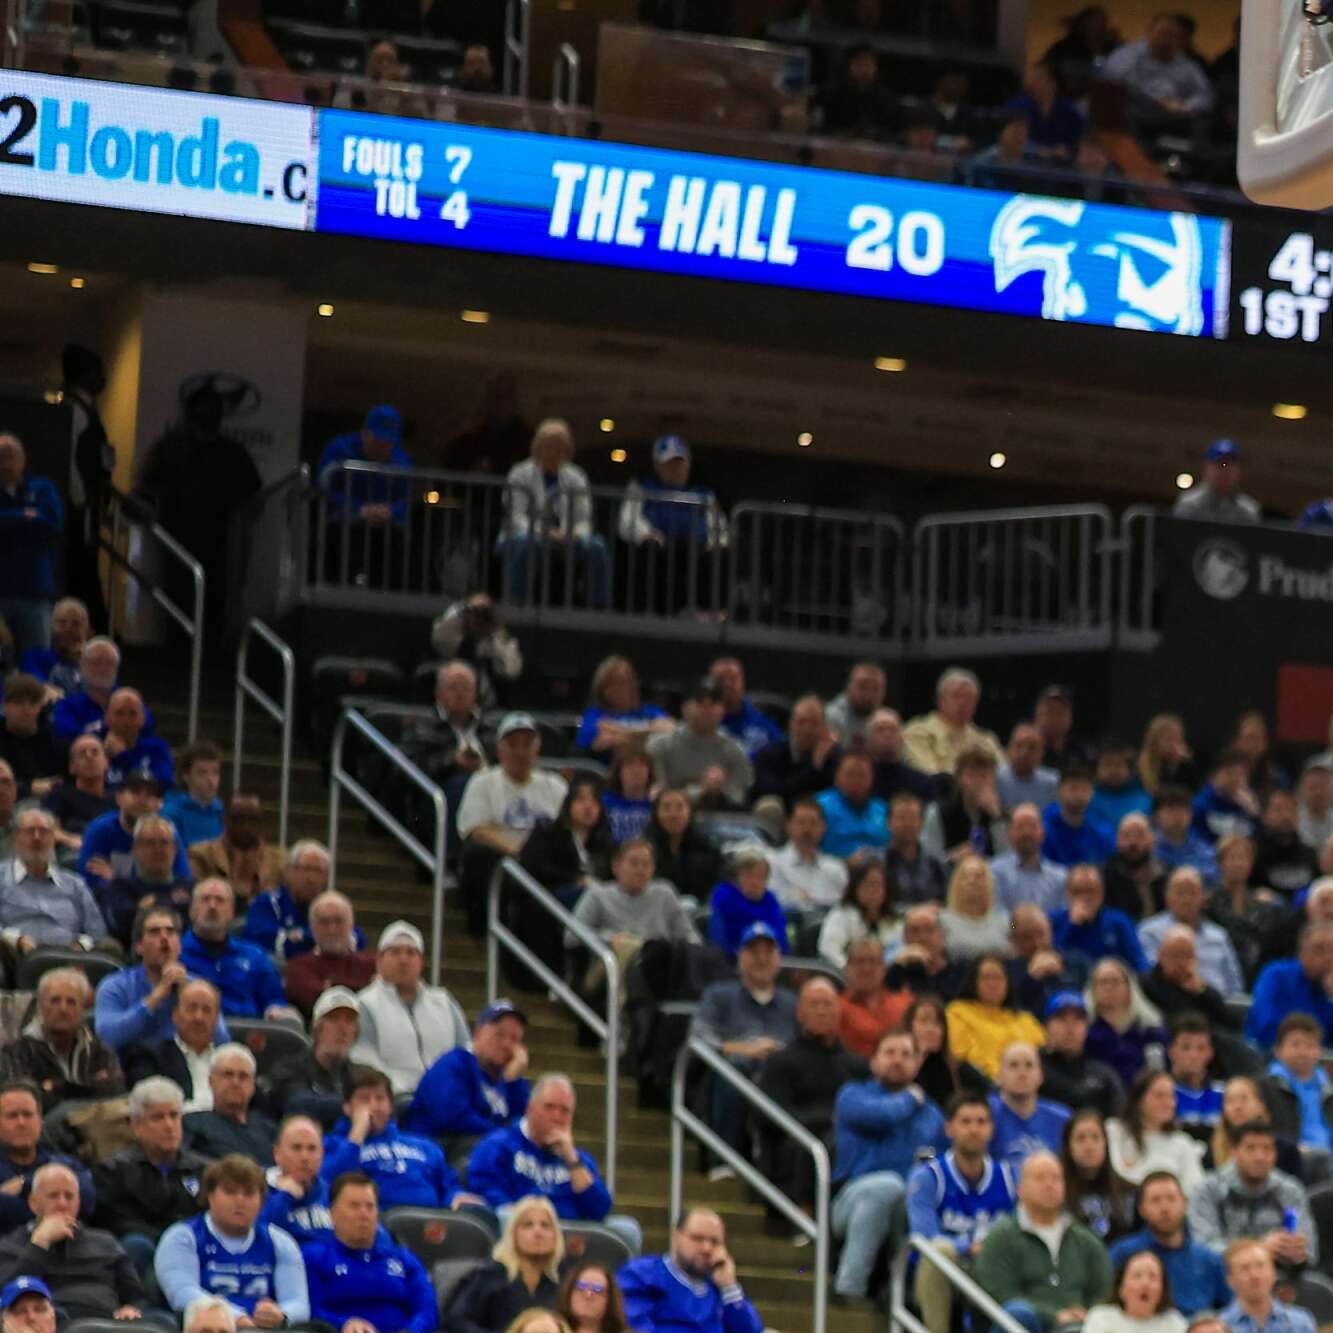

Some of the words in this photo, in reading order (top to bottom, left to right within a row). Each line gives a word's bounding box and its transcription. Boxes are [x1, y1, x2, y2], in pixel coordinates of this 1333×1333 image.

[342, 135, 423, 179] FOULS
[445, 146, 472, 180] 7
[373, 178, 420, 220] TOL
[440, 193, 470, 230] 4
[548, 161, 653, 247] THE
[658, 179, 799, 267] HALL
[845, 204, 946, 276] 20
[1240, 286, 1326, 344] 1ST
